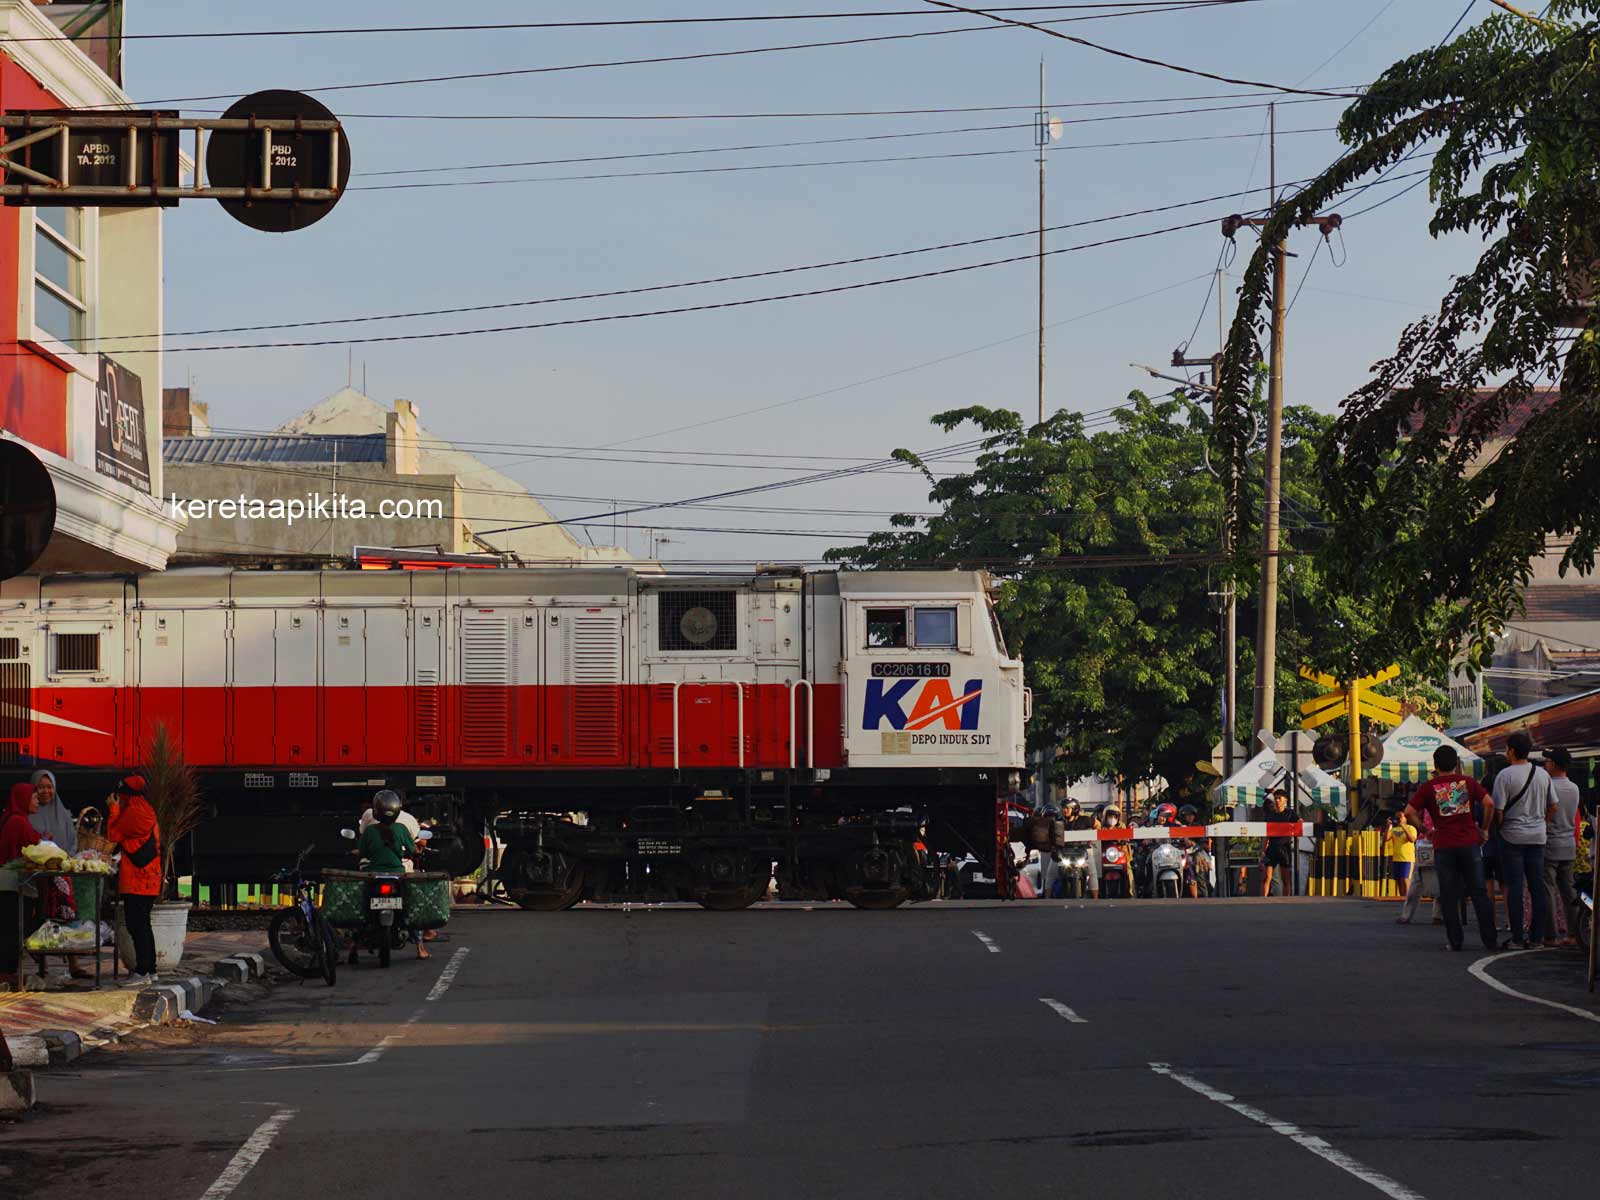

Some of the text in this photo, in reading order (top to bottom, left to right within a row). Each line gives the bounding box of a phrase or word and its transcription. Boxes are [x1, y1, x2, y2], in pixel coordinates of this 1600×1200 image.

[83, 144, 110, 154] APBD
[270, 145, 292, 155] PBD
[77, 155, 116, 165] TA. 2012
[275, 156, 297, 167] 2012
[873, 664, 949, 676] CC206 16 10
[862, 679, 983, 730] KAI
[912, 734, 937, 745] DEPO
[939, 734, 969, 745] INDUK
[971, 734, 991, 745] SDT
